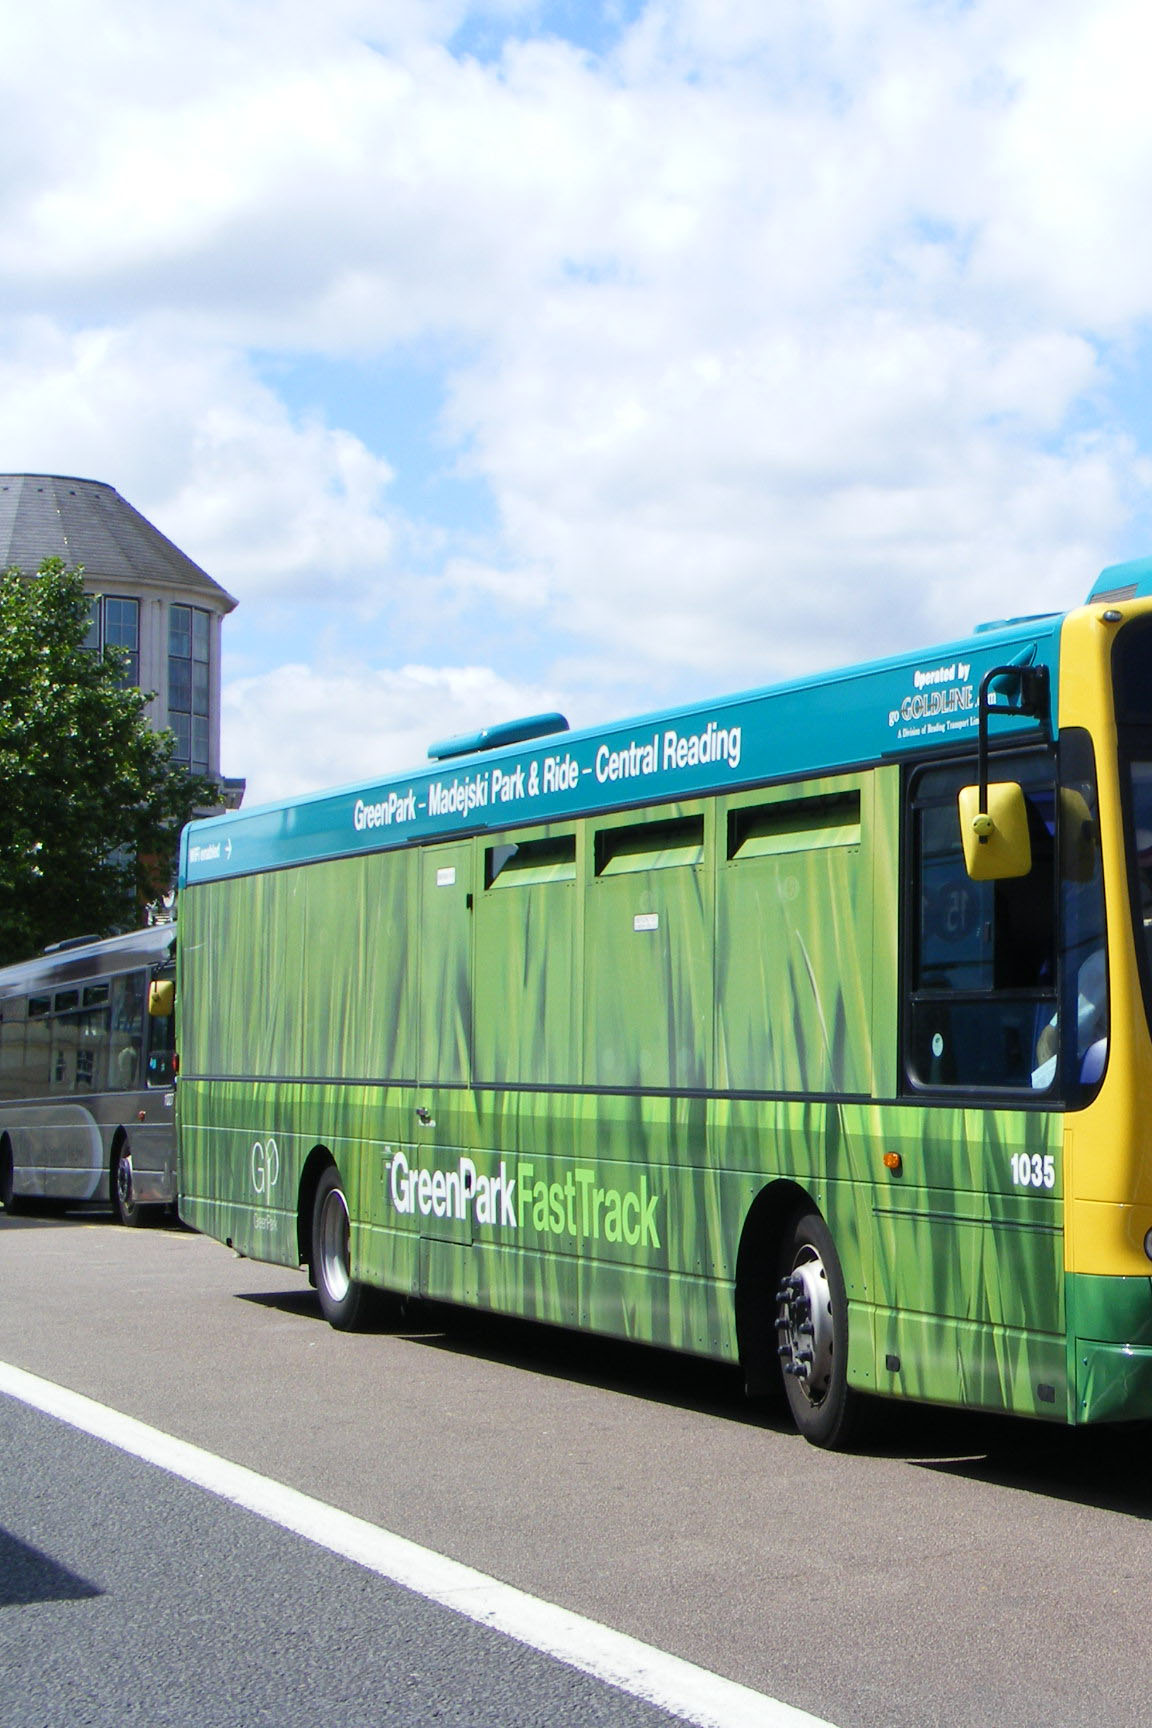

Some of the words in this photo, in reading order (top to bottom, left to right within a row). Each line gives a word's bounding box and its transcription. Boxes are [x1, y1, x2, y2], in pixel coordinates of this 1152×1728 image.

[914, 664, 956, 691] Operated
[957, 662, 971, 682] by
[353, 789, 417, 831] GreenPark
[428, 774, 488, 818] Madejski
[491, 766, 525, 804] Park
[528, 760, 540, 796] &
[543, 753, 580, 794] Ride
[595, 744, 660, 783] Central
[663, 721, 742, 769] Reading
[390, 1151, 517, 1227] GreenPark
[517, 1162, 661, 1249] FastTrack
[1011, 1153, 1055, 1188] 1035
